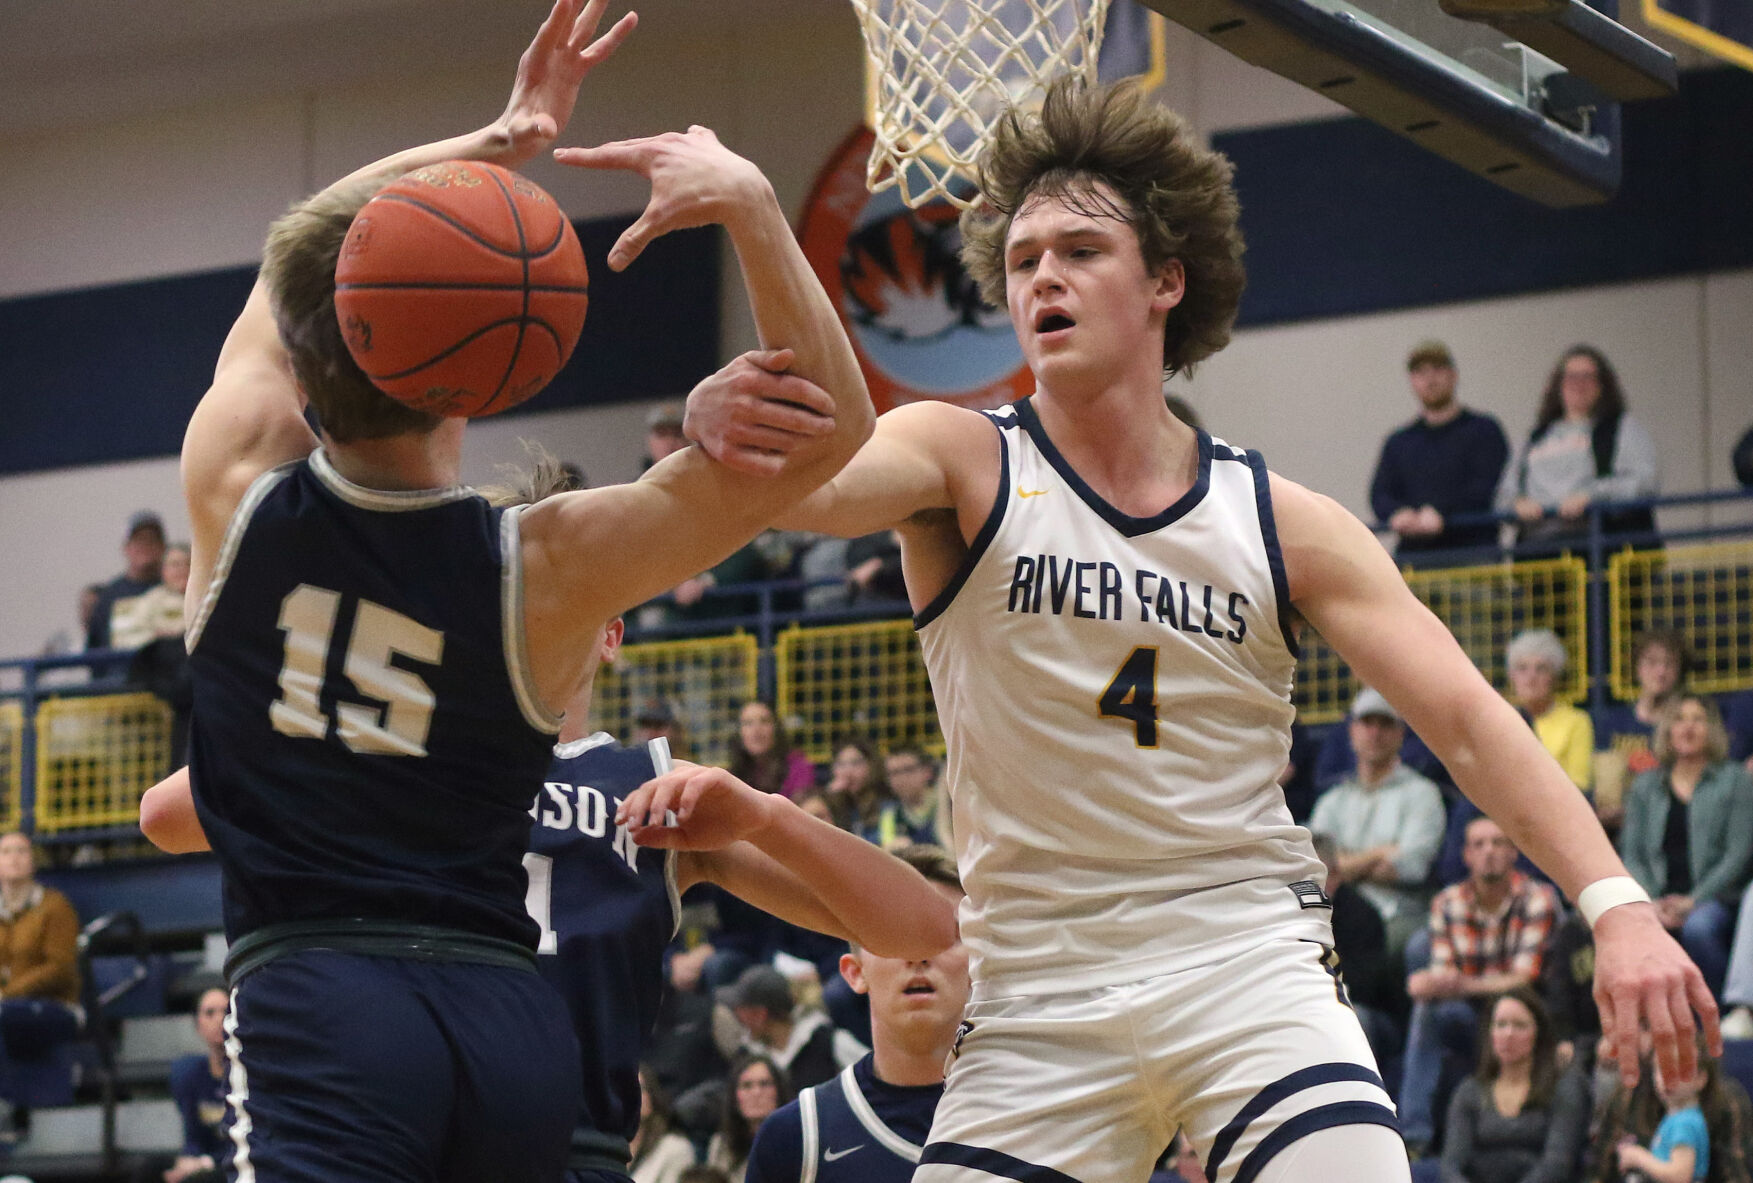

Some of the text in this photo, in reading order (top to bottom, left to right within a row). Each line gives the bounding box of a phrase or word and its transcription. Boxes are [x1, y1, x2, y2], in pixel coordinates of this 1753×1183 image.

[1007, 554, 1250, 645] RIVER FALLS
[268, 582, 445, 758] 15
[1096, 644, 1160, 750] 4
